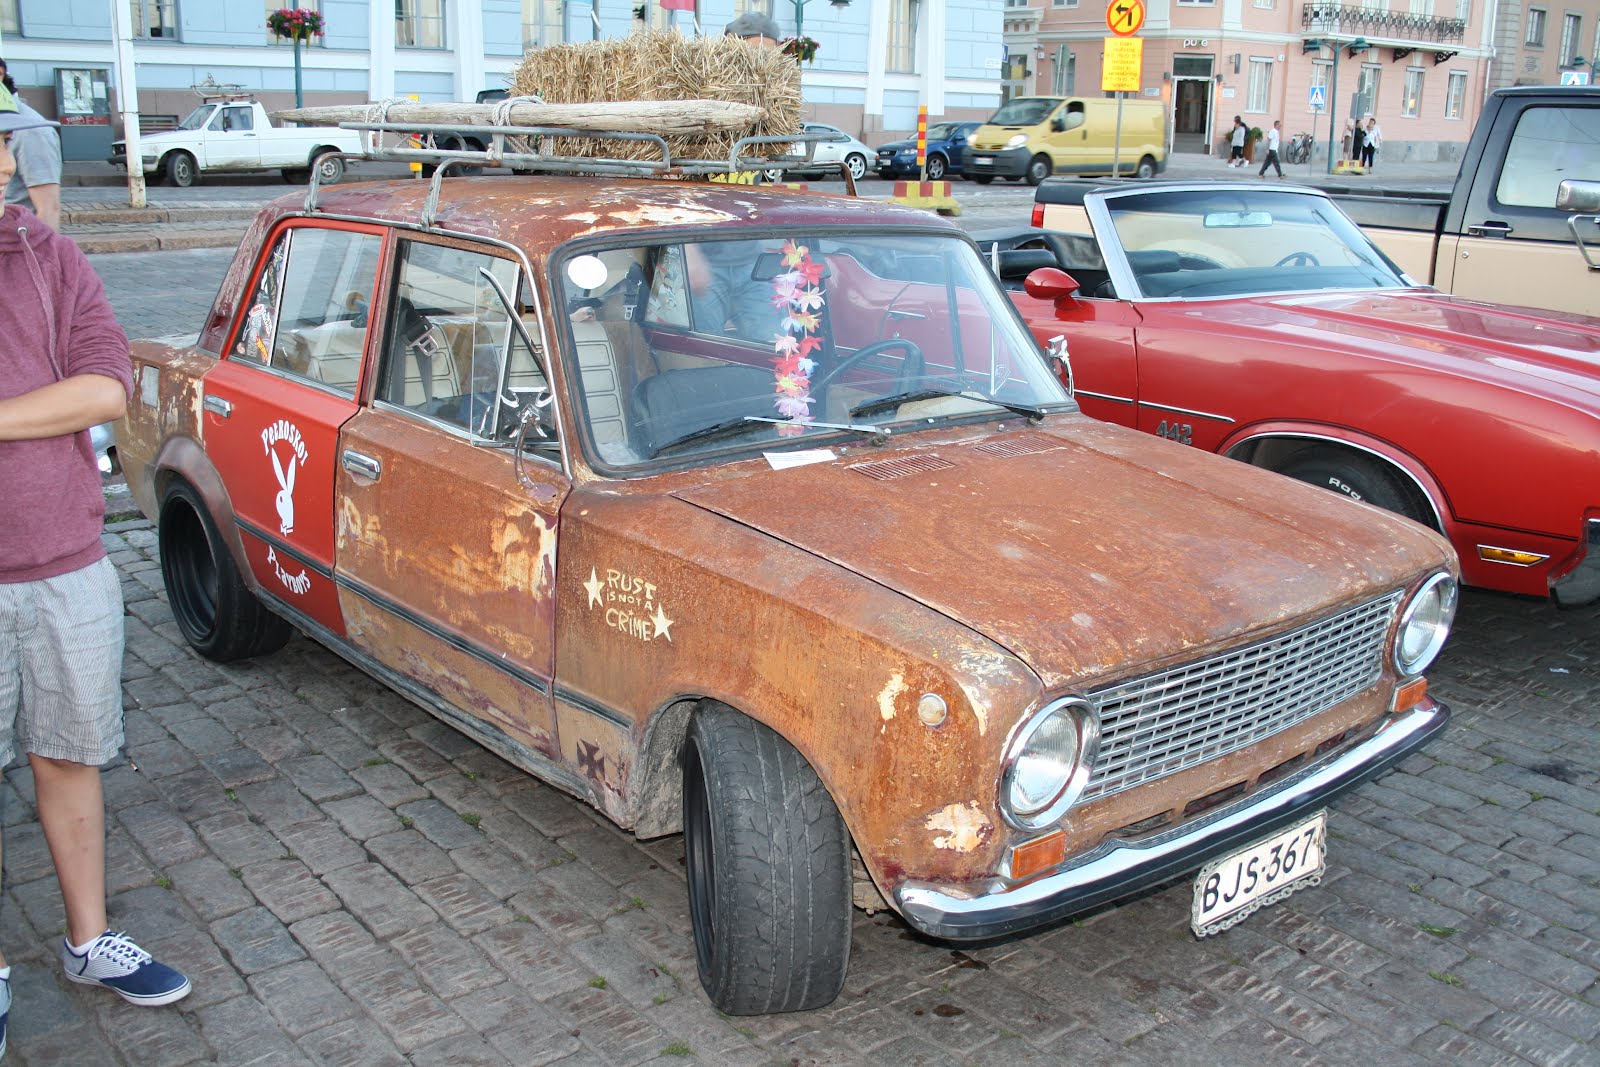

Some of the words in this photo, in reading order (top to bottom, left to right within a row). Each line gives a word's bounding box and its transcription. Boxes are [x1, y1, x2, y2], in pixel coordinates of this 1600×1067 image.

[1183, 38, 1208, 49] pue
[1156, 419, 1192, 445] 442
[606, 568, 657, 600] RUST
[618, 593, 642, 607] NOT
[644, 600, 653, 612] A
[1202, 826, 1317, 914] BJS-367
